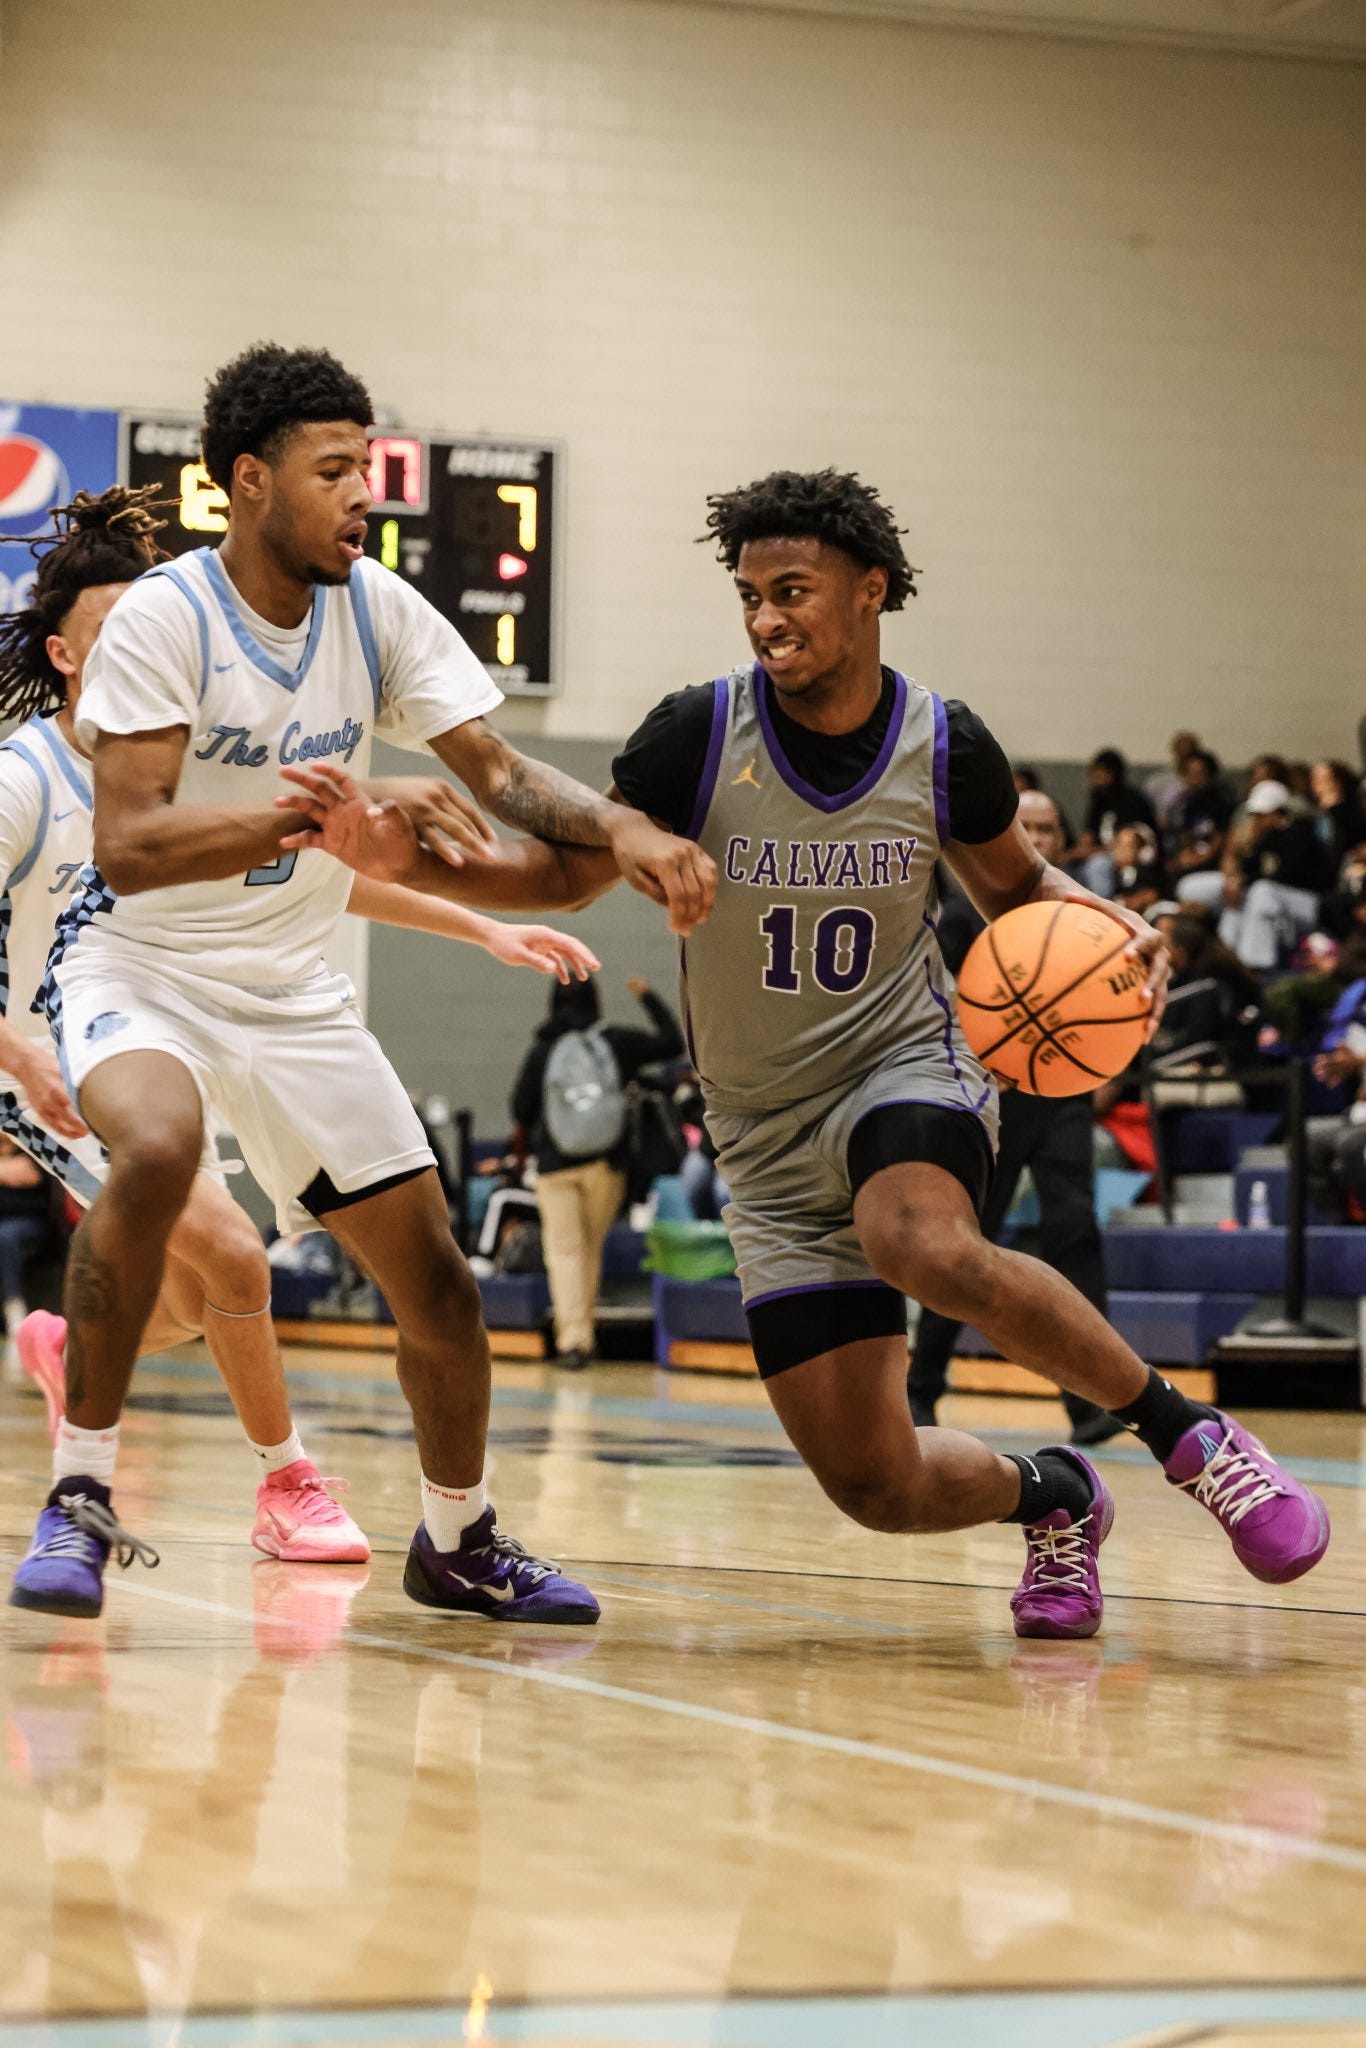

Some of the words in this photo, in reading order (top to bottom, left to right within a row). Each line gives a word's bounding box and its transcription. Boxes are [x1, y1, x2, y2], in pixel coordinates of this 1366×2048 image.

[497, 484, 537, 551] 7
[381, 520, 398, 571] 1
[497, 613, 514, 665] 1
[195, 724, 269, 767] The
[279, 718, 363, 765] County
[725, 835, 917, 889] CALVARY
[759, 904, 876, 995] 10
